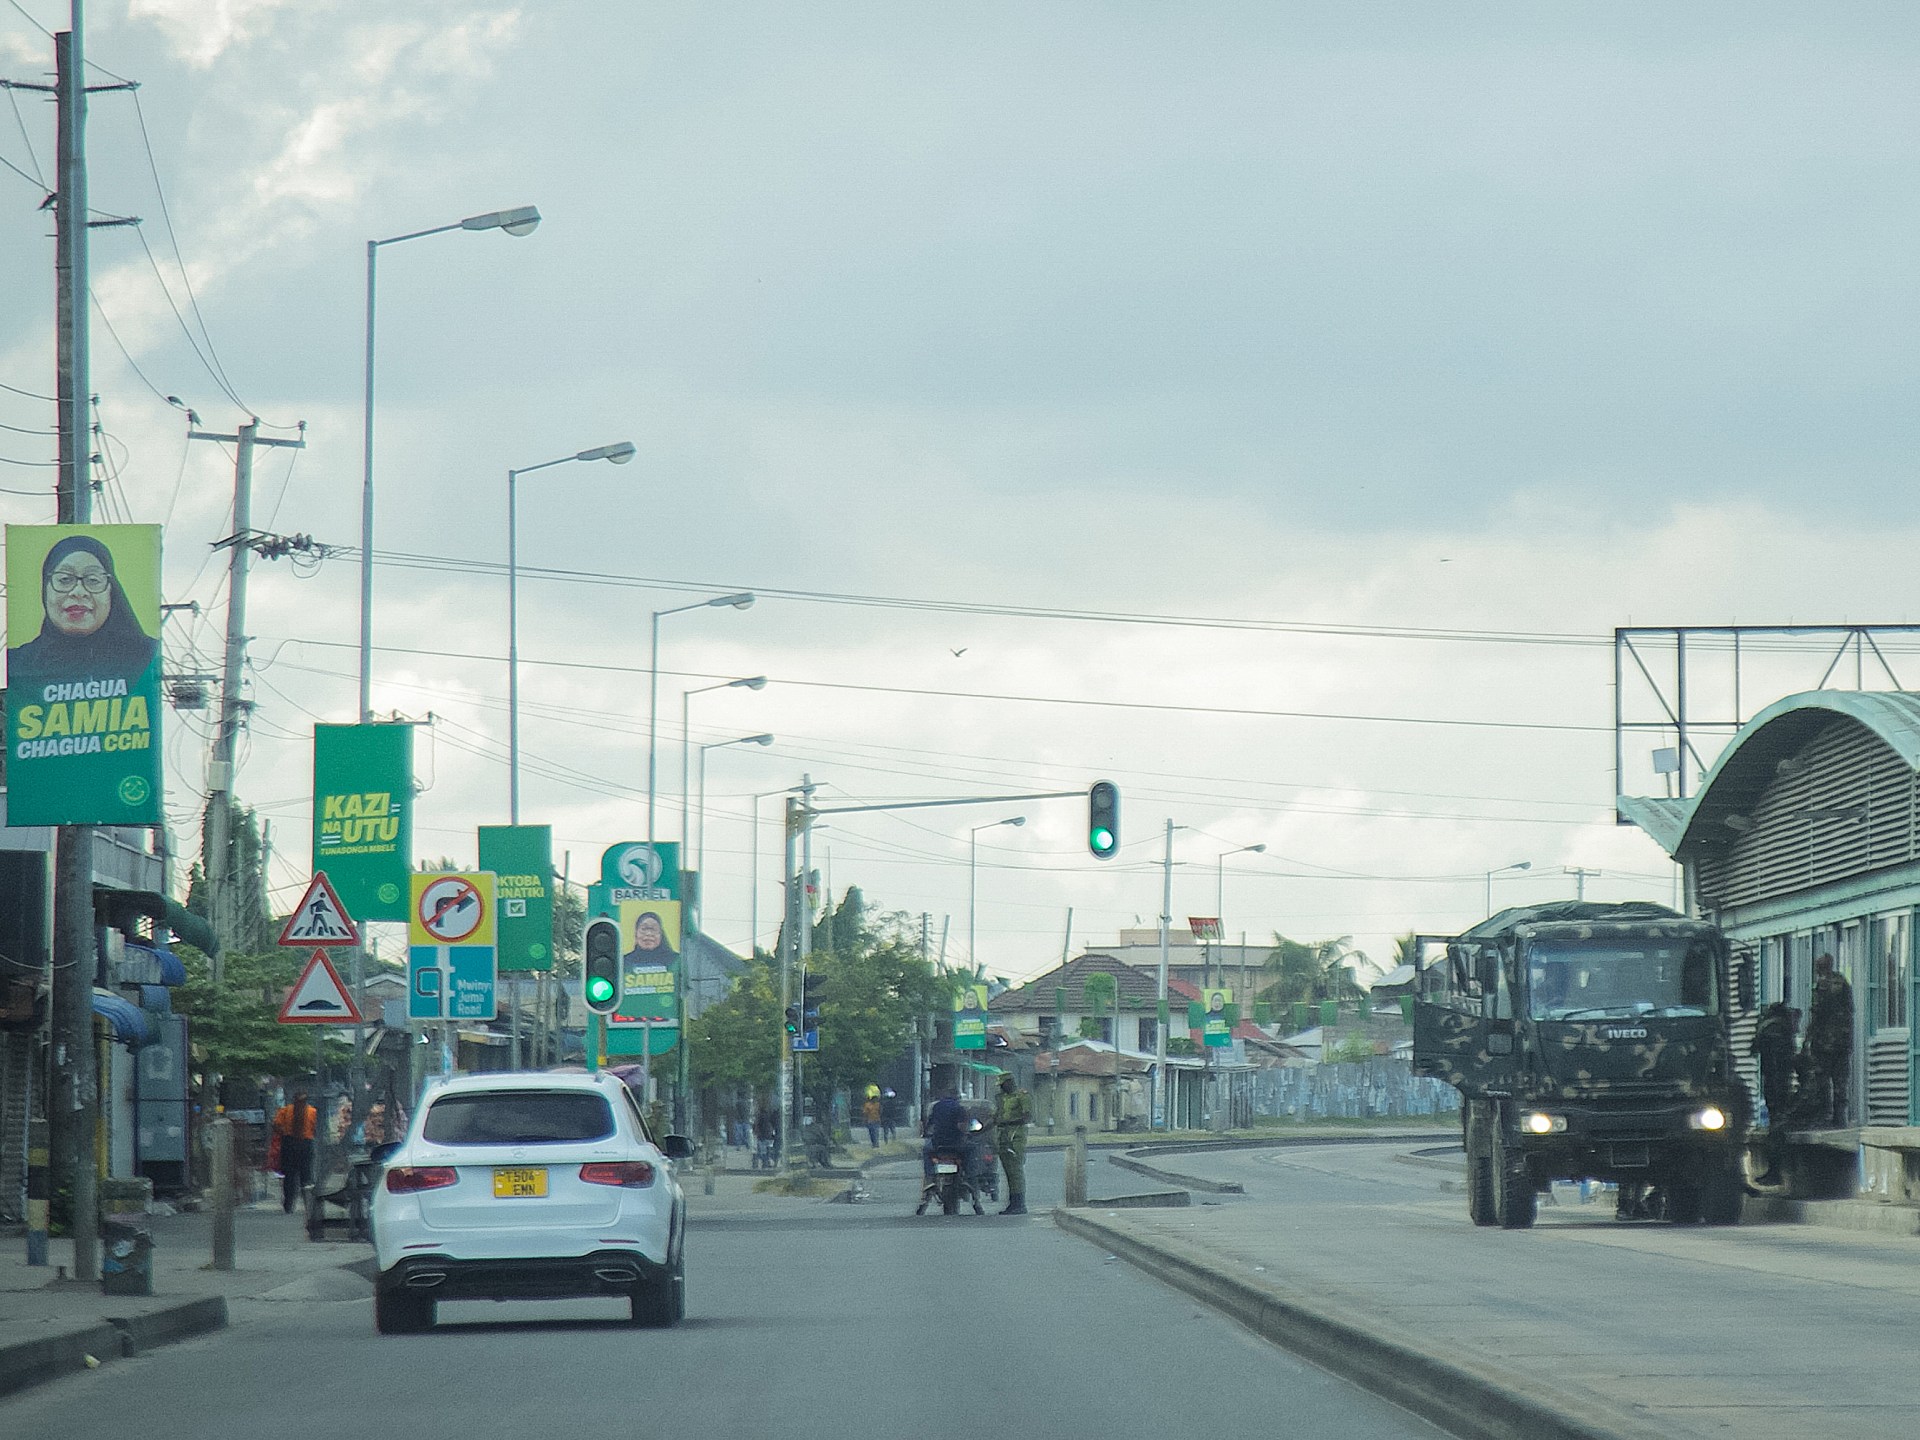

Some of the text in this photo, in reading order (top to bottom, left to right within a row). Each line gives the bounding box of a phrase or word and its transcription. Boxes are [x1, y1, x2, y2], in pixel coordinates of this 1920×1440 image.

[43, 678, 128, 703] CHAGUA
[17, 695, 150, 740] SAMIA
[17, 731, 151, 760] CHAGUA CCM
[324, 792, 391, 819] KAZI
[322, 816, 399, 843] NA UTU
[614, 889, 667, 899] BARREL
[457, 979, 492, 993] Mwinyi
[624, 972, 675, 988] SAMIA
[458, 991, 485, 1003] Juma
[458, 1003, 482, 1015] Road
[1608, 1029, 1648, 1039] IVECO
